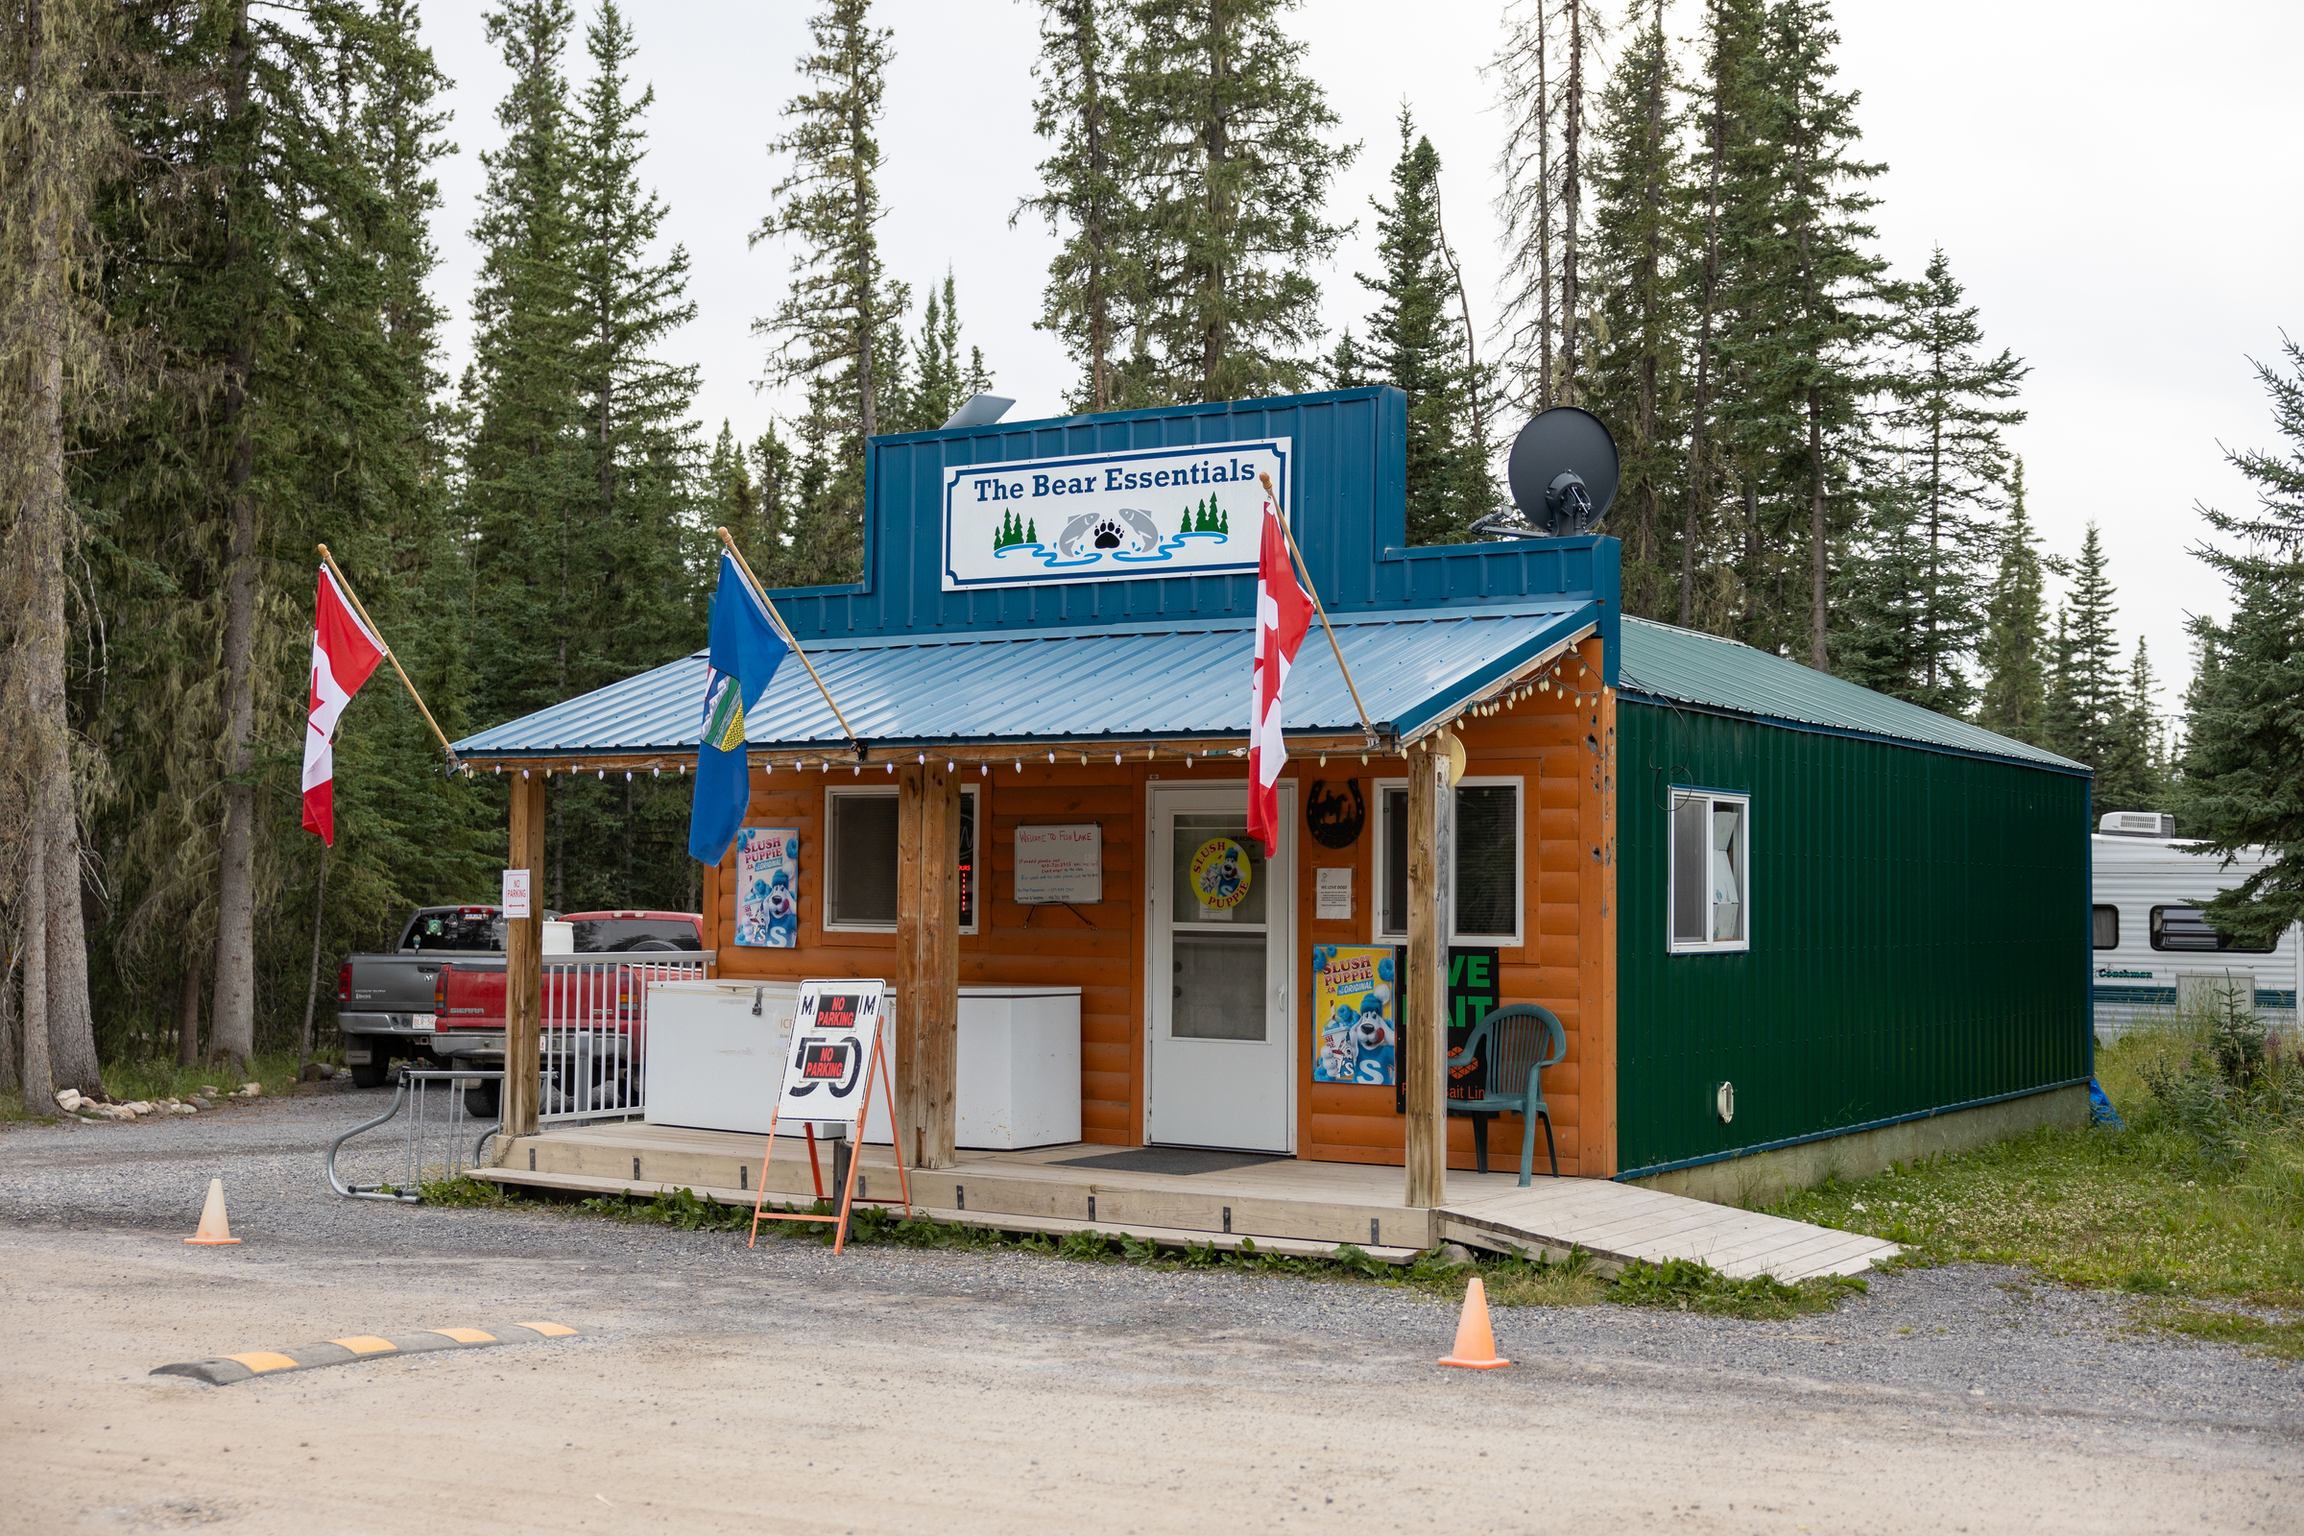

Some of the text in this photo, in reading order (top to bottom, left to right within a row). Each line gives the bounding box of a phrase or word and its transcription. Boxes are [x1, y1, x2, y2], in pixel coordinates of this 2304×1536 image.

[974, 458, 1256, 502] The Bear Essentials
[744, 837, 782, 854] SLUSH
[745, 848, 783, 864] PUPPIE
[1193, 842, 1225, 874] SLUSH
[508, 889, 527, 898] PARKING
[1208, 880, 1249, 908] PUPPIE
[1323, 955, 1372, 975] SLUSH
[1324, 968, 1374, 986] PUPPIE
[832, 997, 845, 1011] NO
[817, 1011, 854, 1026] PARKING
[820, 1047, 834, 1061] NO
[805, 1062, 843, 1077] PARKING
[1447, 1085, 1463, 1099] ait
